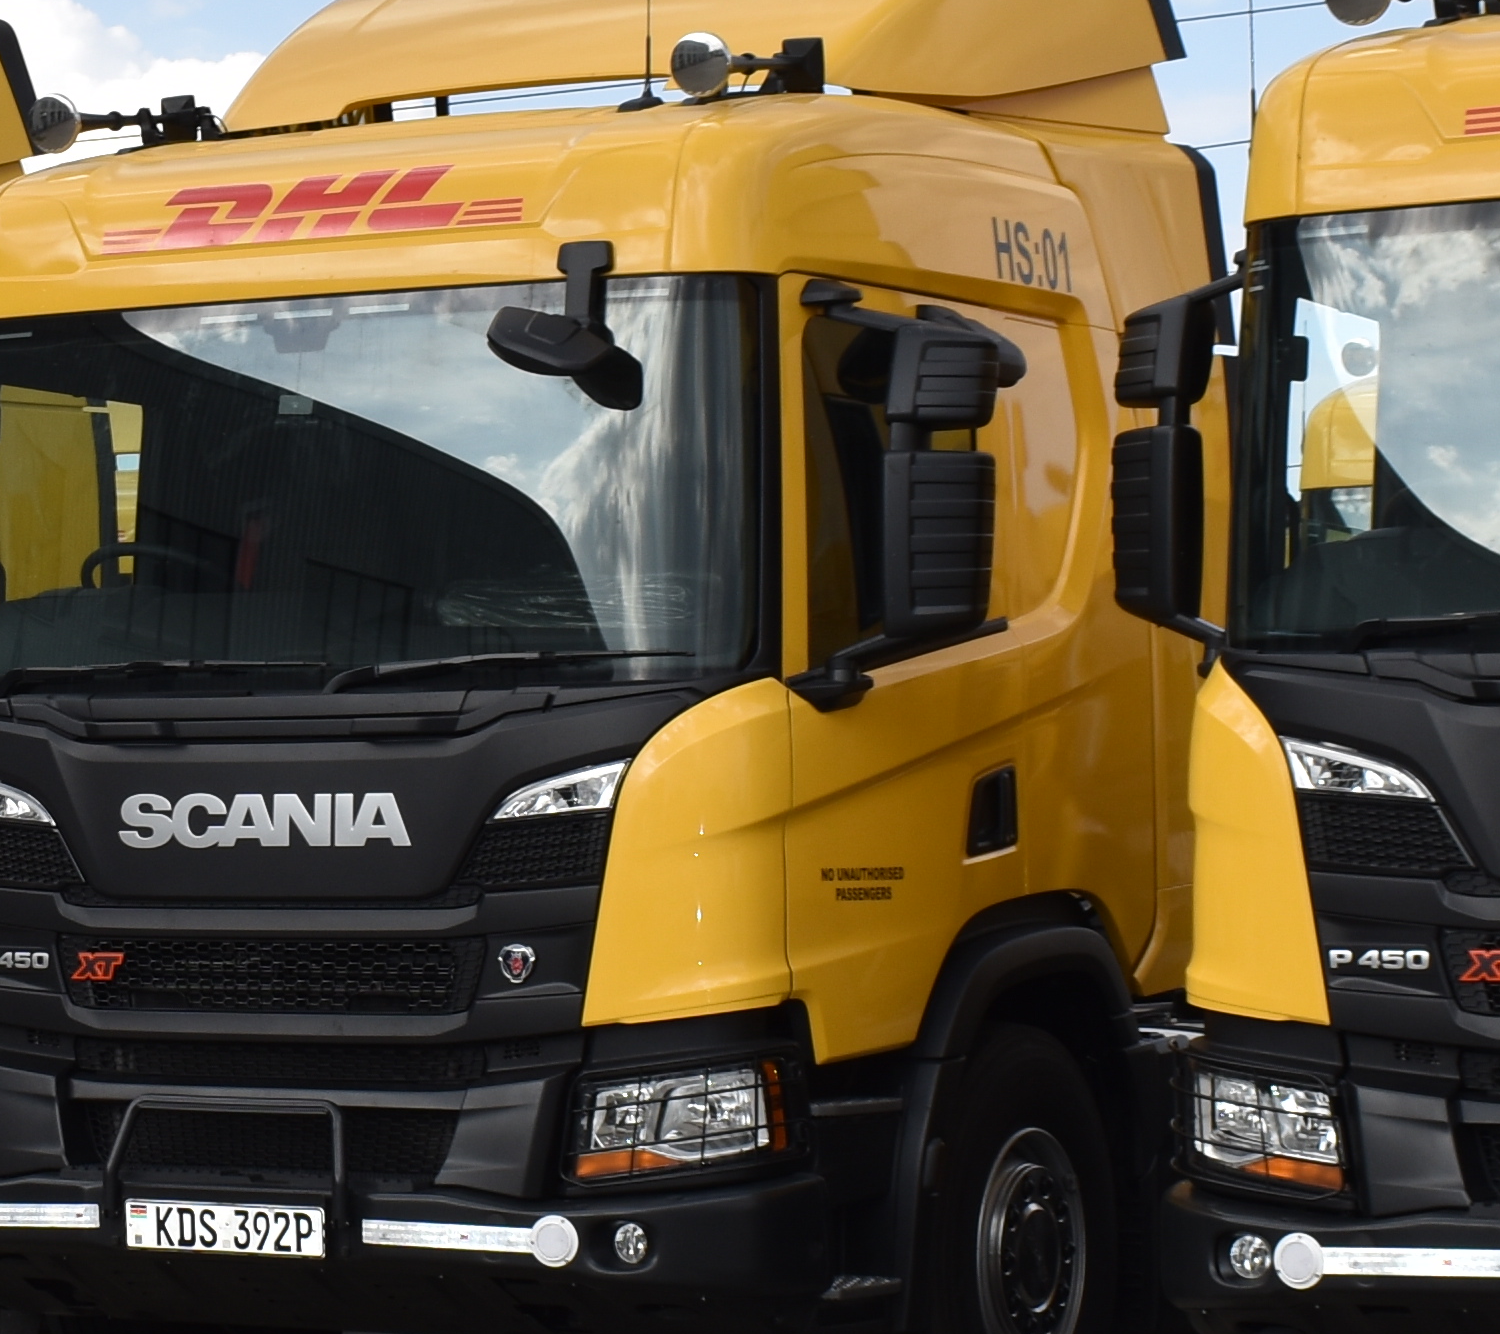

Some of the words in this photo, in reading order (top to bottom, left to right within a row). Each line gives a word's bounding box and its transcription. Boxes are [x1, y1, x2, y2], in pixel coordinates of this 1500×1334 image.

[152, 164, 465, 251] DHL
[991, 216, 1072, 293] HS:01
[118, 792, 412, 849] SCANIA
[71, 951, 124, 981] XT
[1328, 950, 1352, 969] P
[1357, 950, 1430, 970] 450
[155, 1206, 218, 1248] KDS
[233, 1209, 313, 1253] 392P
